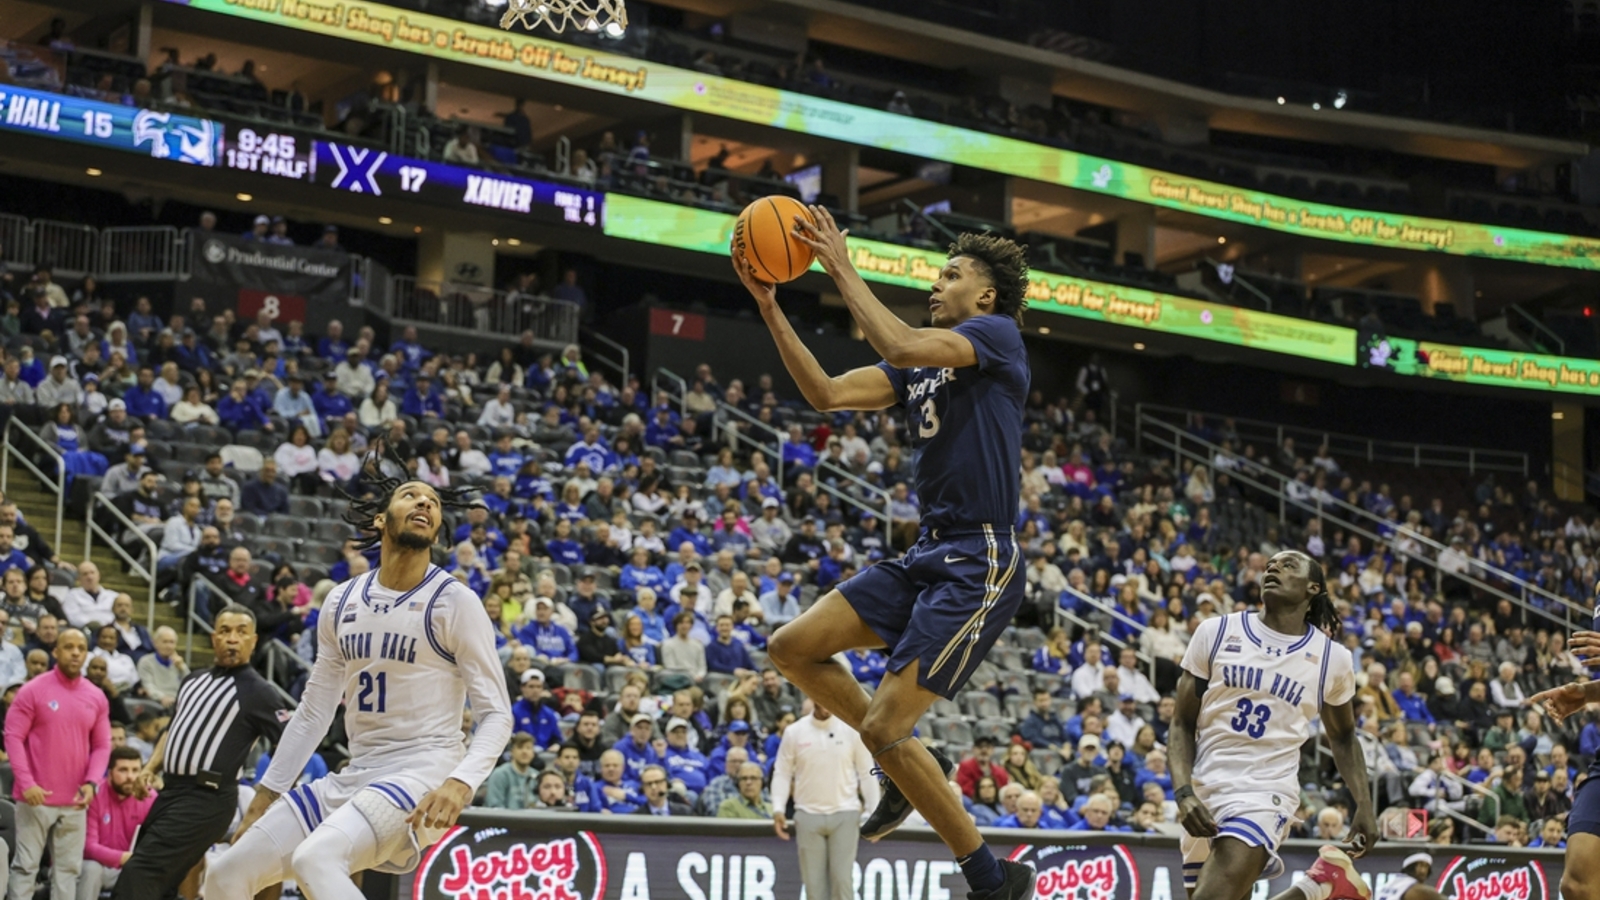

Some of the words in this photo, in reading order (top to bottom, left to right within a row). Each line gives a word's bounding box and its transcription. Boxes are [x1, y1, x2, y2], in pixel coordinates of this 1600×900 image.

[346, 7, 394, 43] Shaq
[398, 15, 432, 45] has
[434, 31, 449, 49] a
[452, 28, 552, 70] Scratch-Off
[552, 48, 580, 76] for
[582, 55, 647, 92] Jersey!
[6, 94, 61, 132] HALL
[82, 109, 113, 138] 15
[238, 128, 296, 160] 9:45
[227, 149, 260, 172] 1ST
[261, 156, 307, 179] HALF
[399, 165, 427, 193] 17
[463, 174, 534, 213] XAVIER
[1150, 176, 1187, 201] Giant
[1188, 184, 1229, 211] News!
[1230, 193, 1262, 224] Shaq
[1263, 201, 1287, 223] has
[1376, 217, 1399, 240] for
[1400, 221, 1454, 249] Jersey!
[584, 211, 596, 226] 4
[227, 247, 297, 272] Prudential
[297, 258, 339, 277] Center
[856, 246, 907, 276] News!
[910, 256, 941, 283] Sha
[263, 295, 280, 319] 8
[671, 313, 685, 334] 7
[1081, 286, 1105, 311] for
[1106, 292, 1162, 325] Jersey!
[1429, 350, 1469, 374] Giant
[1471, 356, 1519, 378] News!
[1521, 360, 1558, 388] Shaq
[1560, 362, 1587, 385] has
[919, 397, 940, 439] 3
[380, 632, 418, 664] HALL
[357, 671, 387, 713] 21
[1223, 664, 1264, 691] SETON
[1269, 672, 1306, 708] HALL
[1231, 697, 1272, 739] 33
[440, 838, 578, 894] Jersey
[620, 852, 650, 900] A
[677, 852, 776, 900] SUB
[1036, 856, 1118, 897] ersey
[1451, 865, 1531, 900] Jersey
